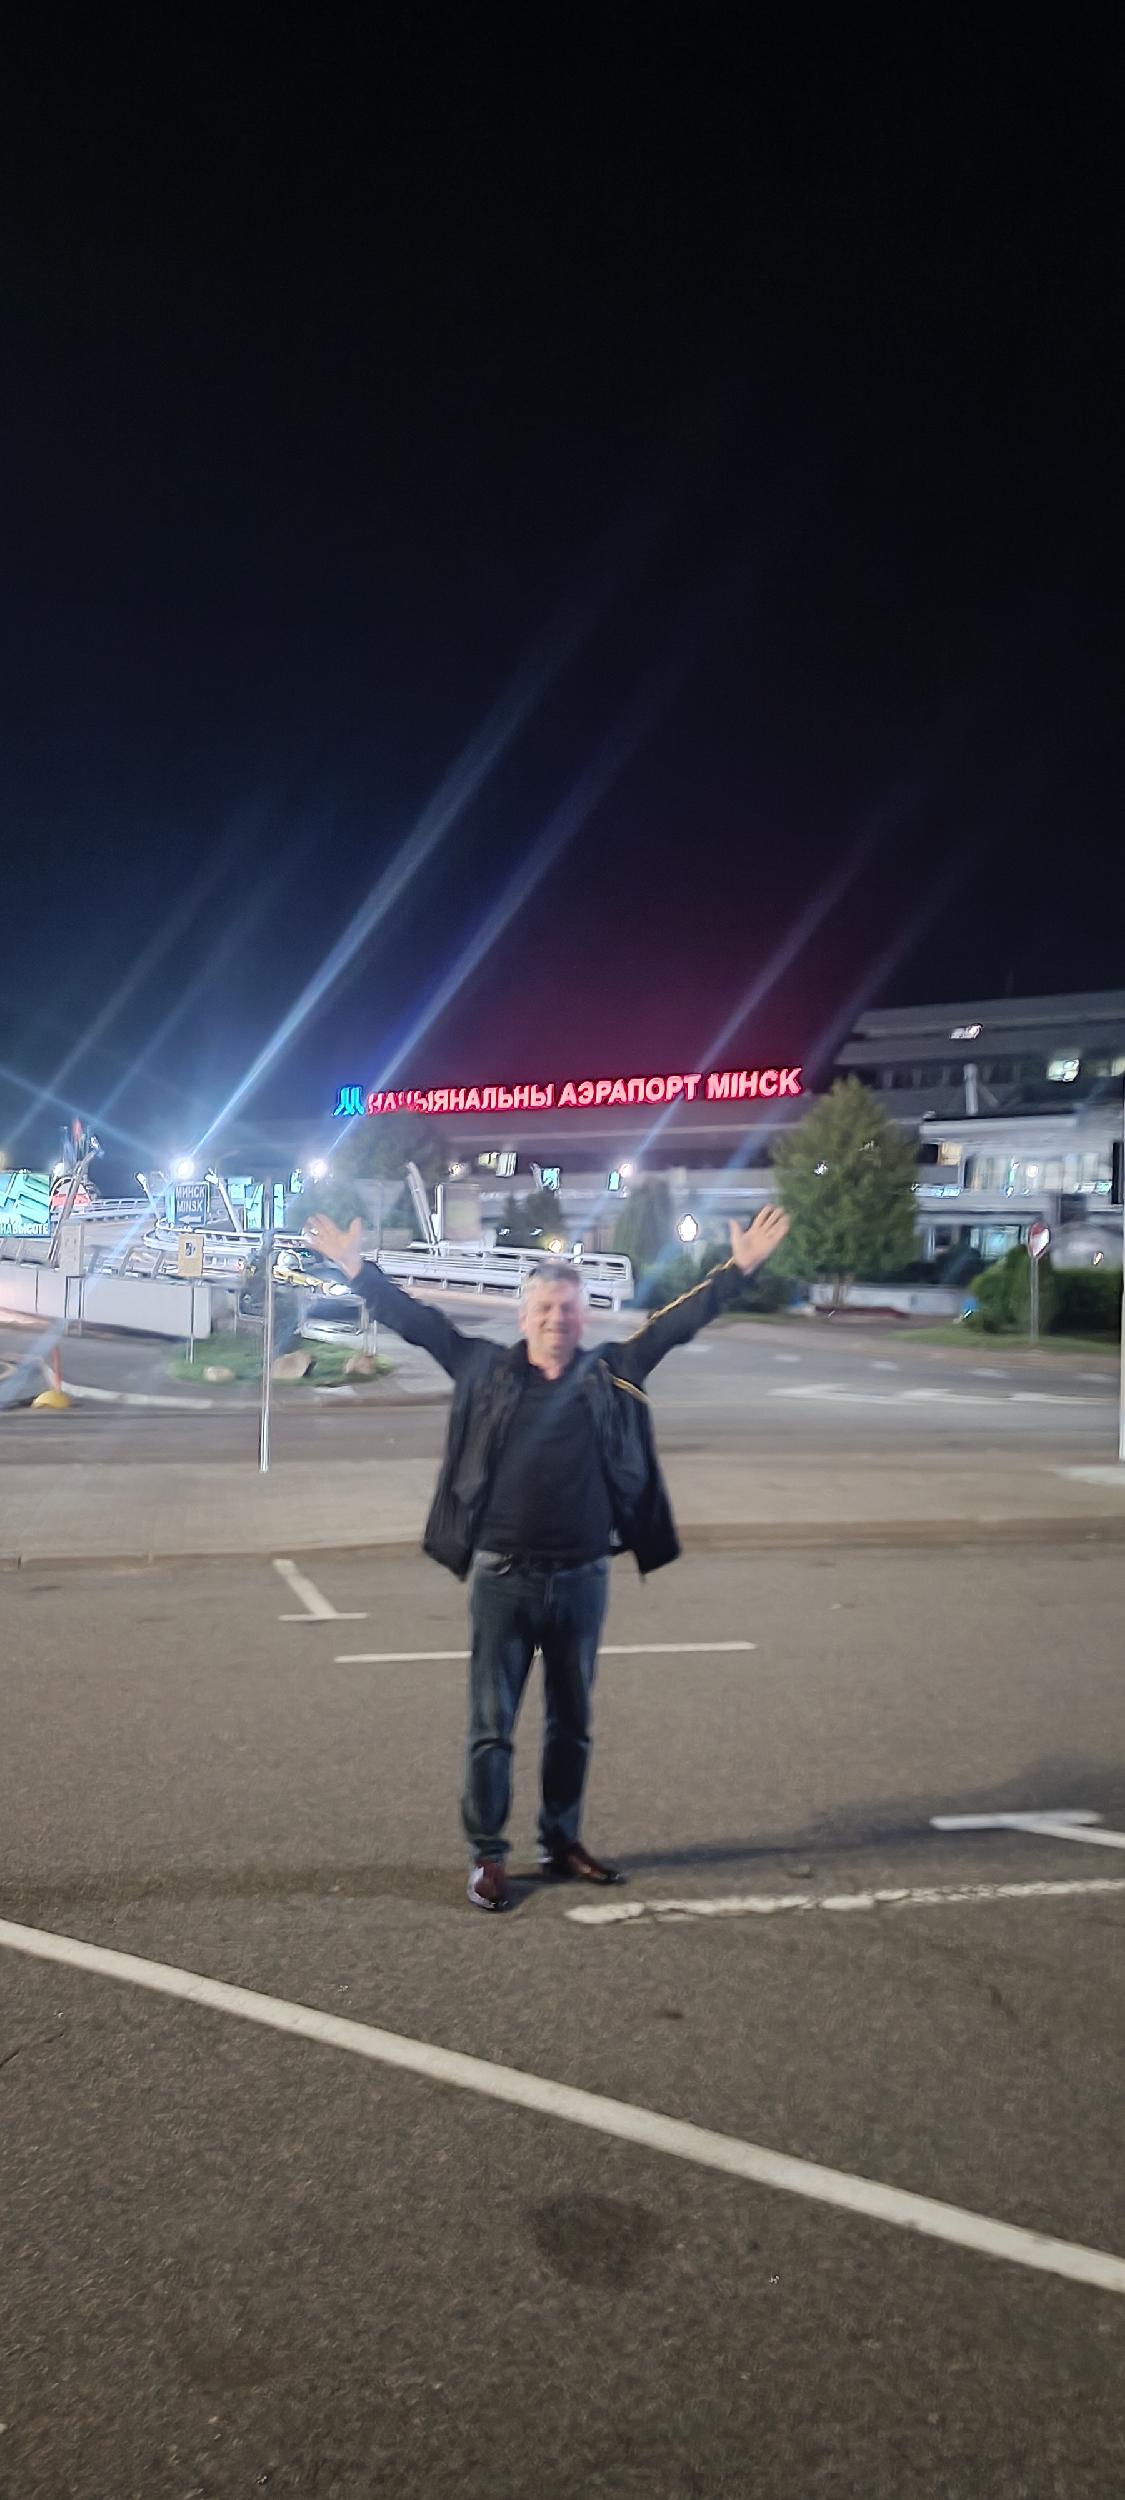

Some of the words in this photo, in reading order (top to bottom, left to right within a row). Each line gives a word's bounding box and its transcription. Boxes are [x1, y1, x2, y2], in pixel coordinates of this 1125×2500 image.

[557, 1074, 701, 1106] АЭРАПОРТ
[707, 1068, 802, 1099] МІНСК
[175, 1186, 205, 1199] МИНСК
[176, 1200, 203, 1213] MINSK
